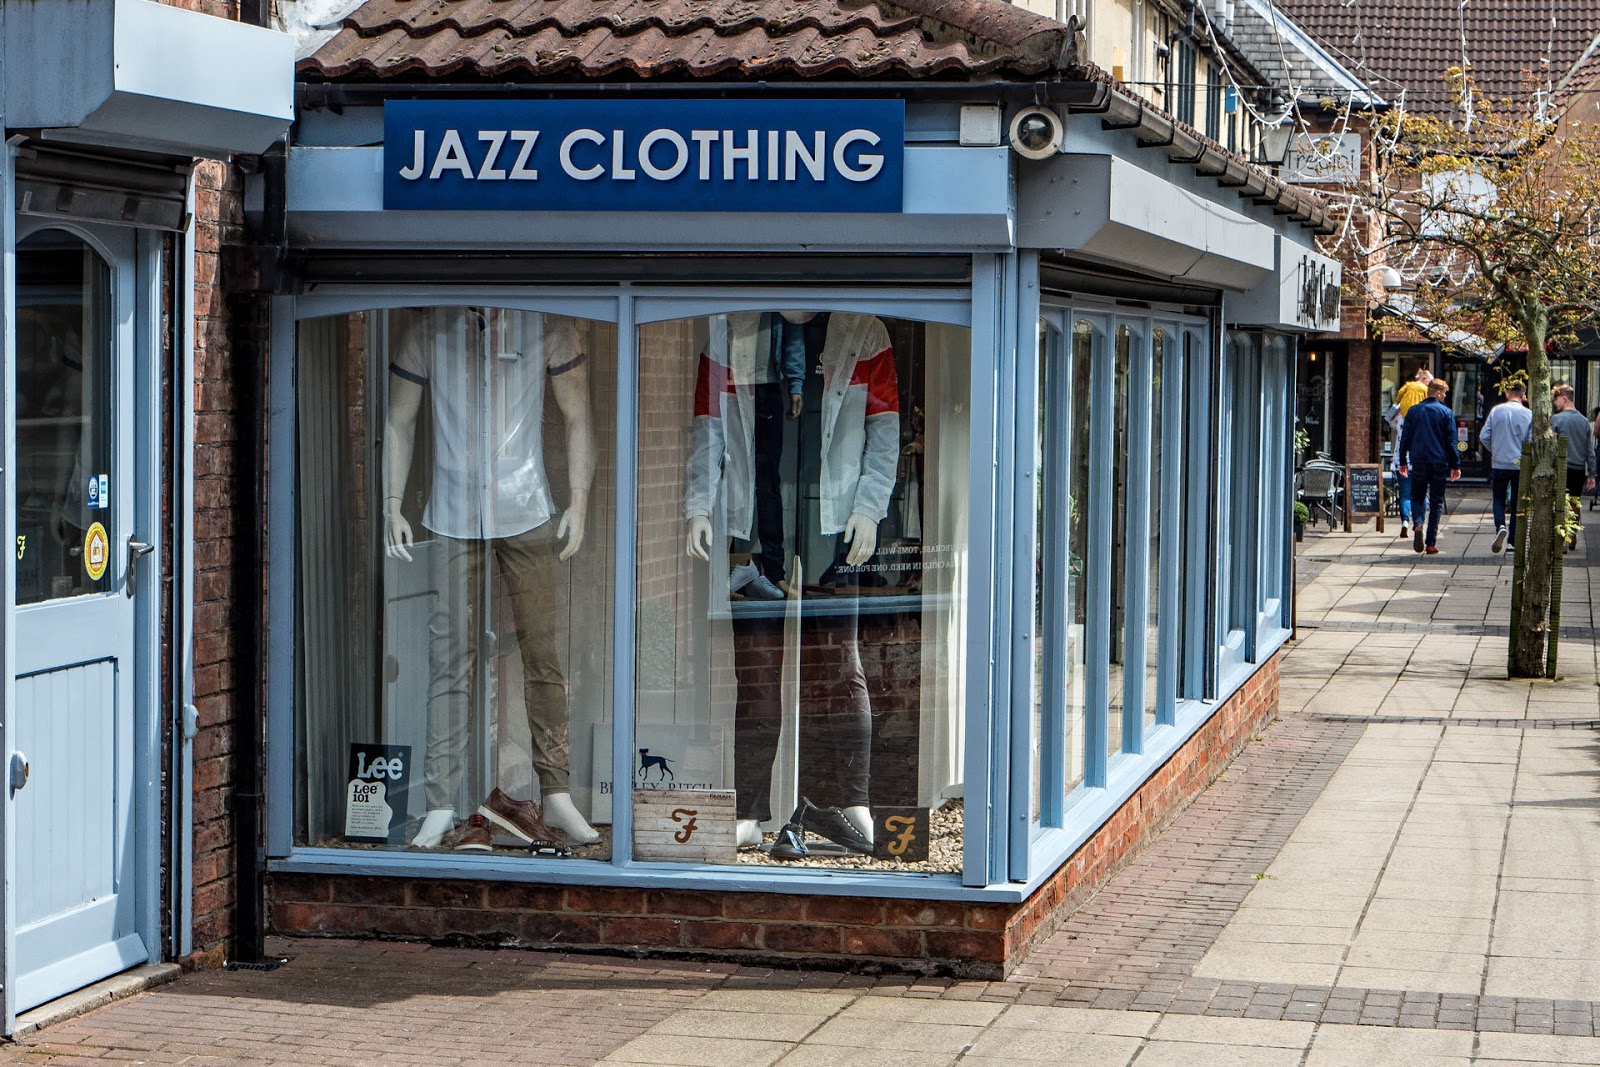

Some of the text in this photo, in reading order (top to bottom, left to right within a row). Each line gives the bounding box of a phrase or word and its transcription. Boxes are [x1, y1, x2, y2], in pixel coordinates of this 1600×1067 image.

[398, 128, 885, 182] JAZZ CLOTHING
[357, 752, 402, 780] Lee
[352, 794, 370, 802] 101
[353, 785, 377, 794] Lee
